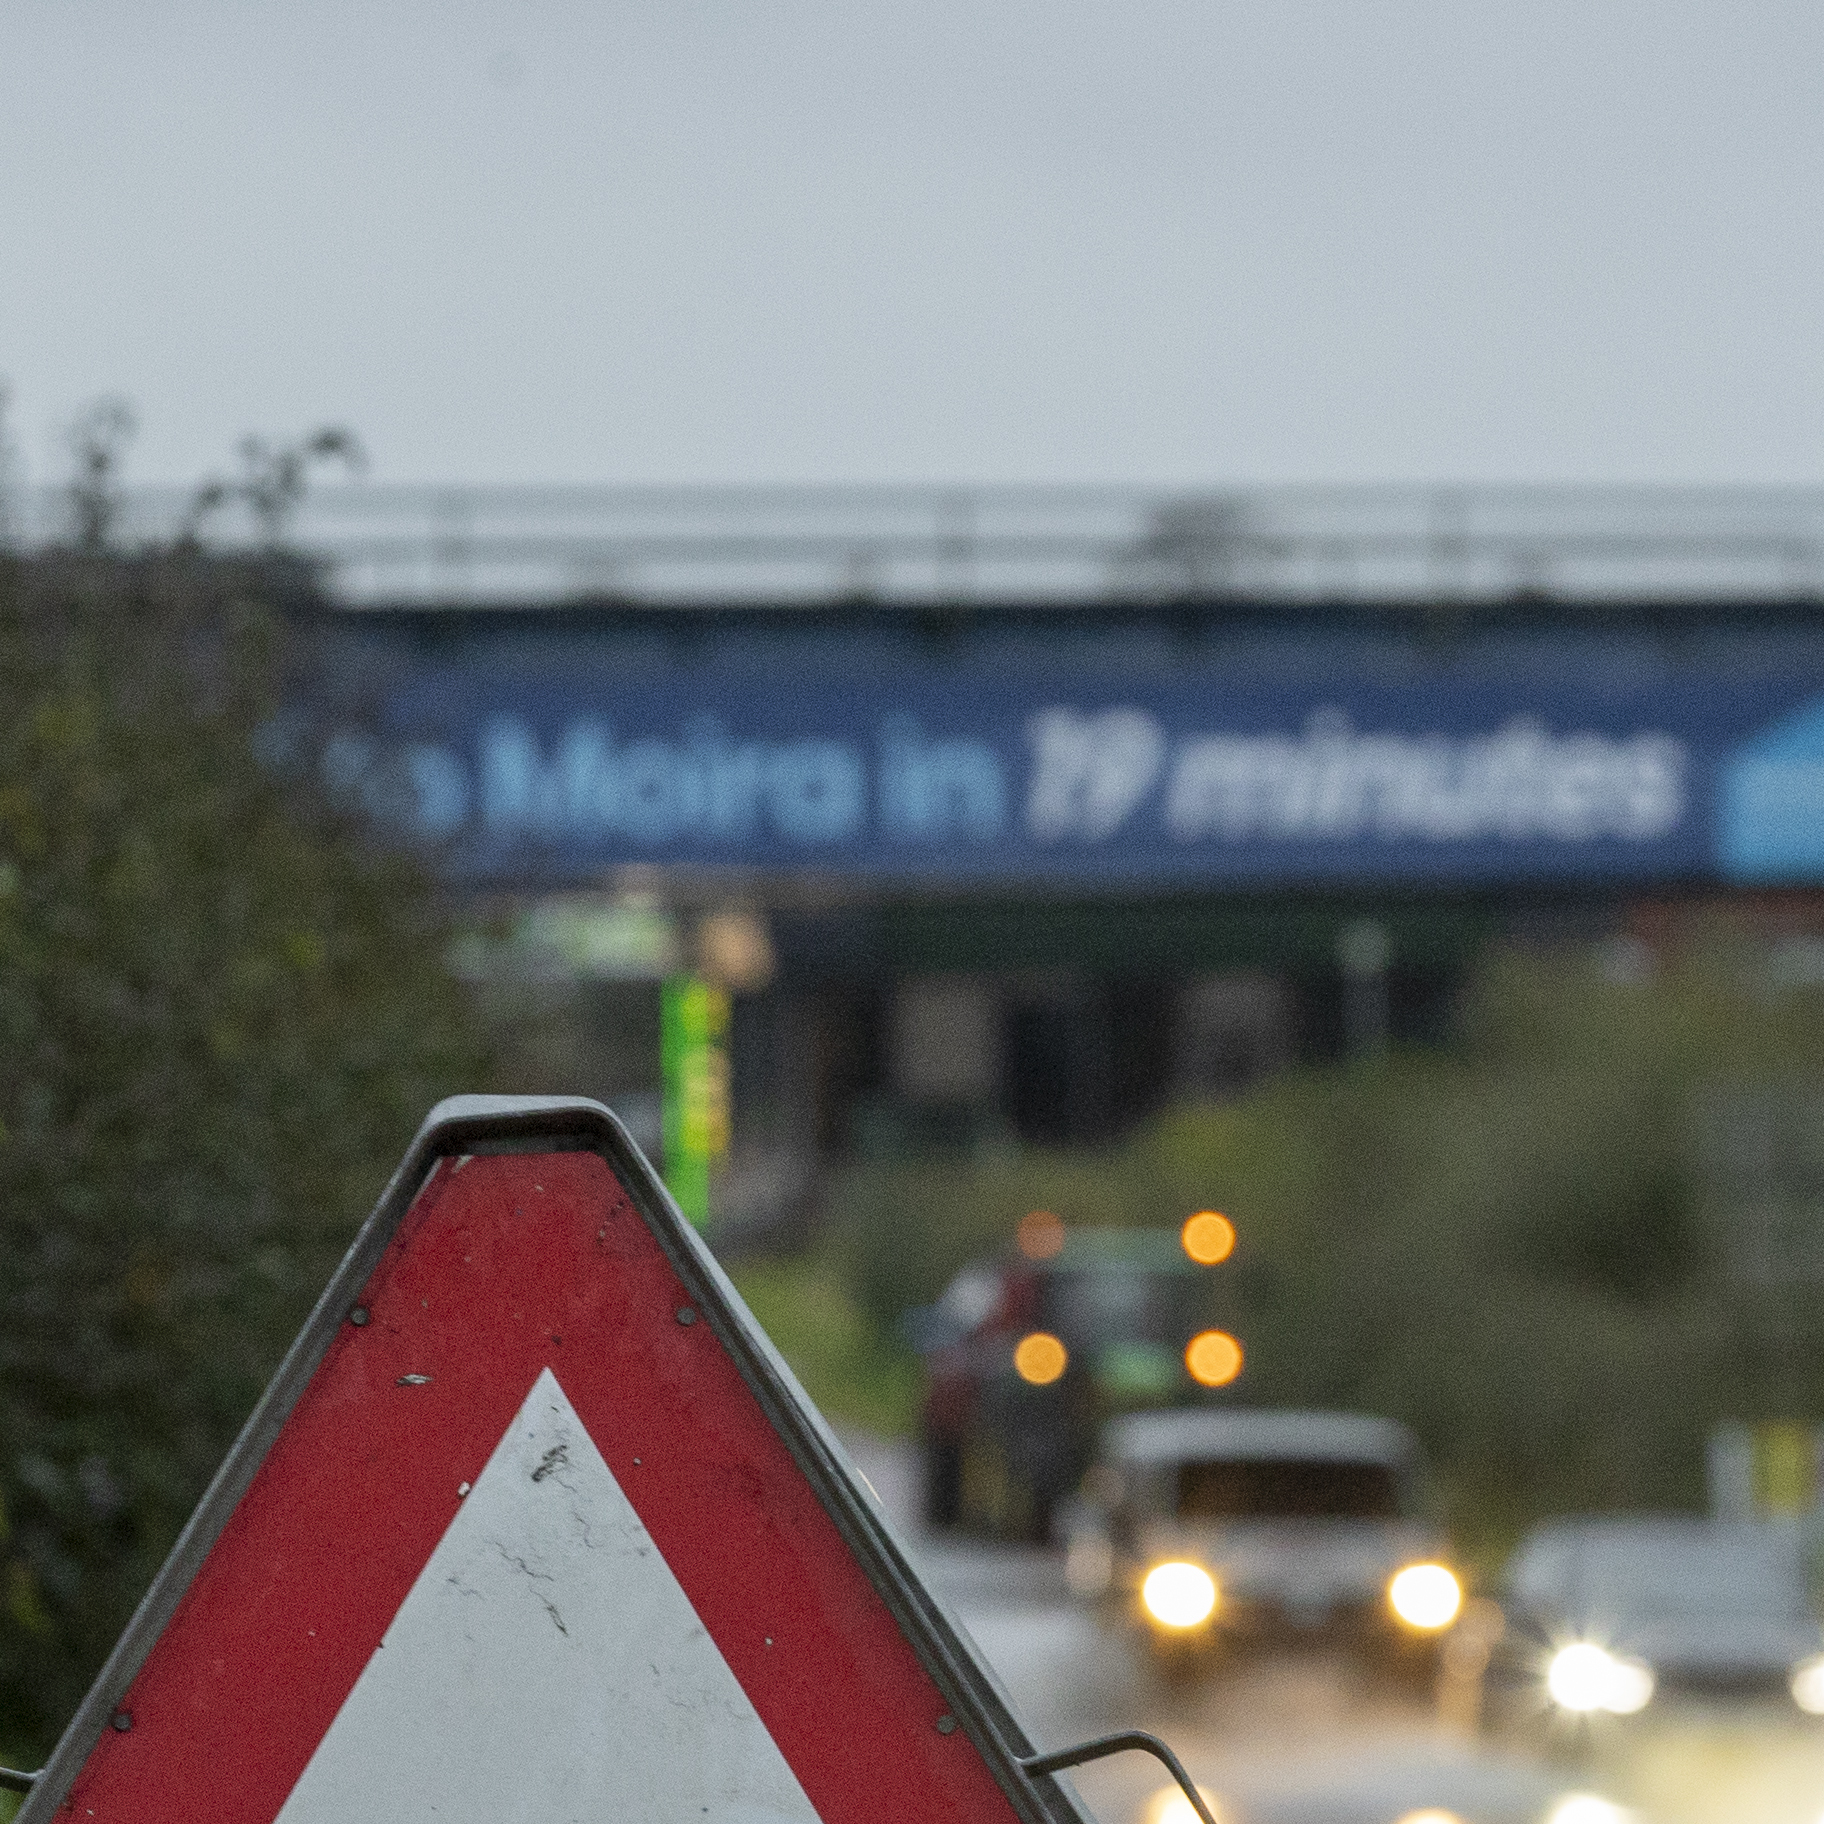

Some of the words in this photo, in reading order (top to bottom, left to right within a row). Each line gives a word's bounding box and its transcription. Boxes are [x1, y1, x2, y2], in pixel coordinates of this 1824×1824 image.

[482, 714, 864, 844] Moira
[884, 711, 1006, 843] in
[1026, 706, 1164, 840] 19
[1166, 707, 1682, 840] minutes
